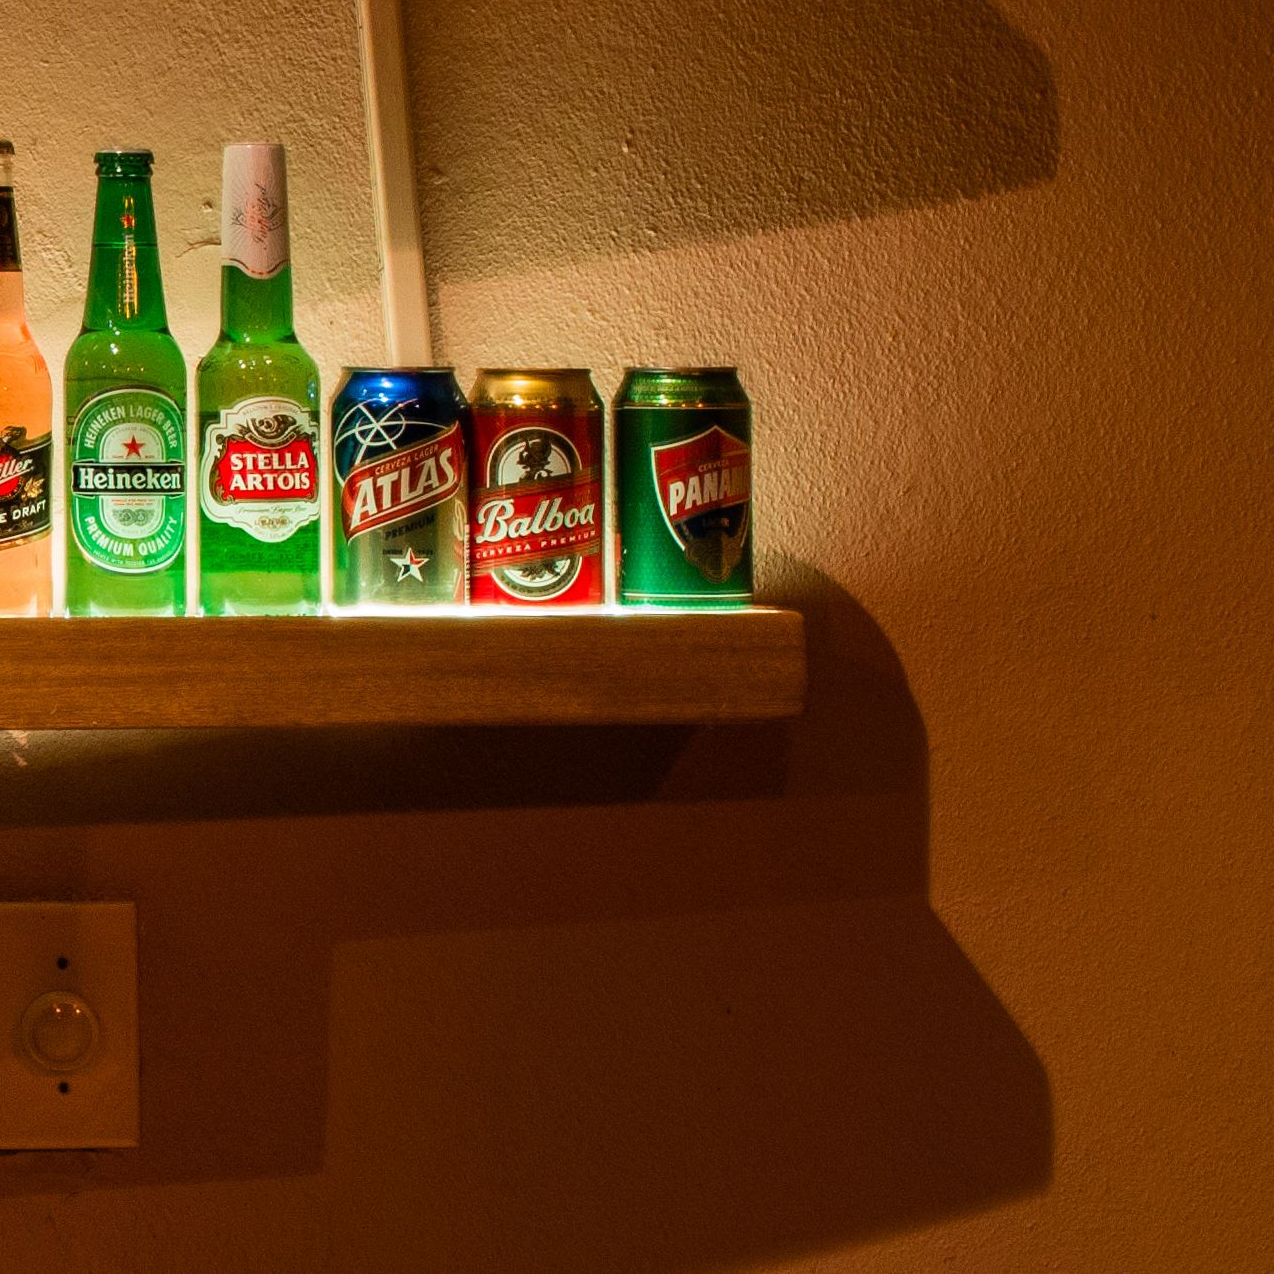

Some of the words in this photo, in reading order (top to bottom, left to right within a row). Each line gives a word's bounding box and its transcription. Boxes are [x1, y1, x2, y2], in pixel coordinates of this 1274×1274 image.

[83, 405, 126, 449] HEINEKEN
[127, 404, 165, 426] LAGER
[161, 418, 179, 450] BEER
[230, 452, 310, 471] STELLA
[374, 455, 412, 475] CERVEZA
[413, 443, 440, 464] LAGER
[78, 467, 182, 491] Heineken
[229, 472, 311, 491] ARTOIS
[349, 446, 455, 527] ATLAS
[668, 464, 751, 517] PANAM
[11, 498, 48, 521] DRAFT
[475, 496, 595, 544] Balboa
[83, 515, 135, 557] PREMIUM
[138, 515, 179, 558] QUALITY
[384, 514, 436, 541] PREMIUM
[474, 542, 532, 560] CERVEZA
[540, 528, 597, 550] PREMIUM
